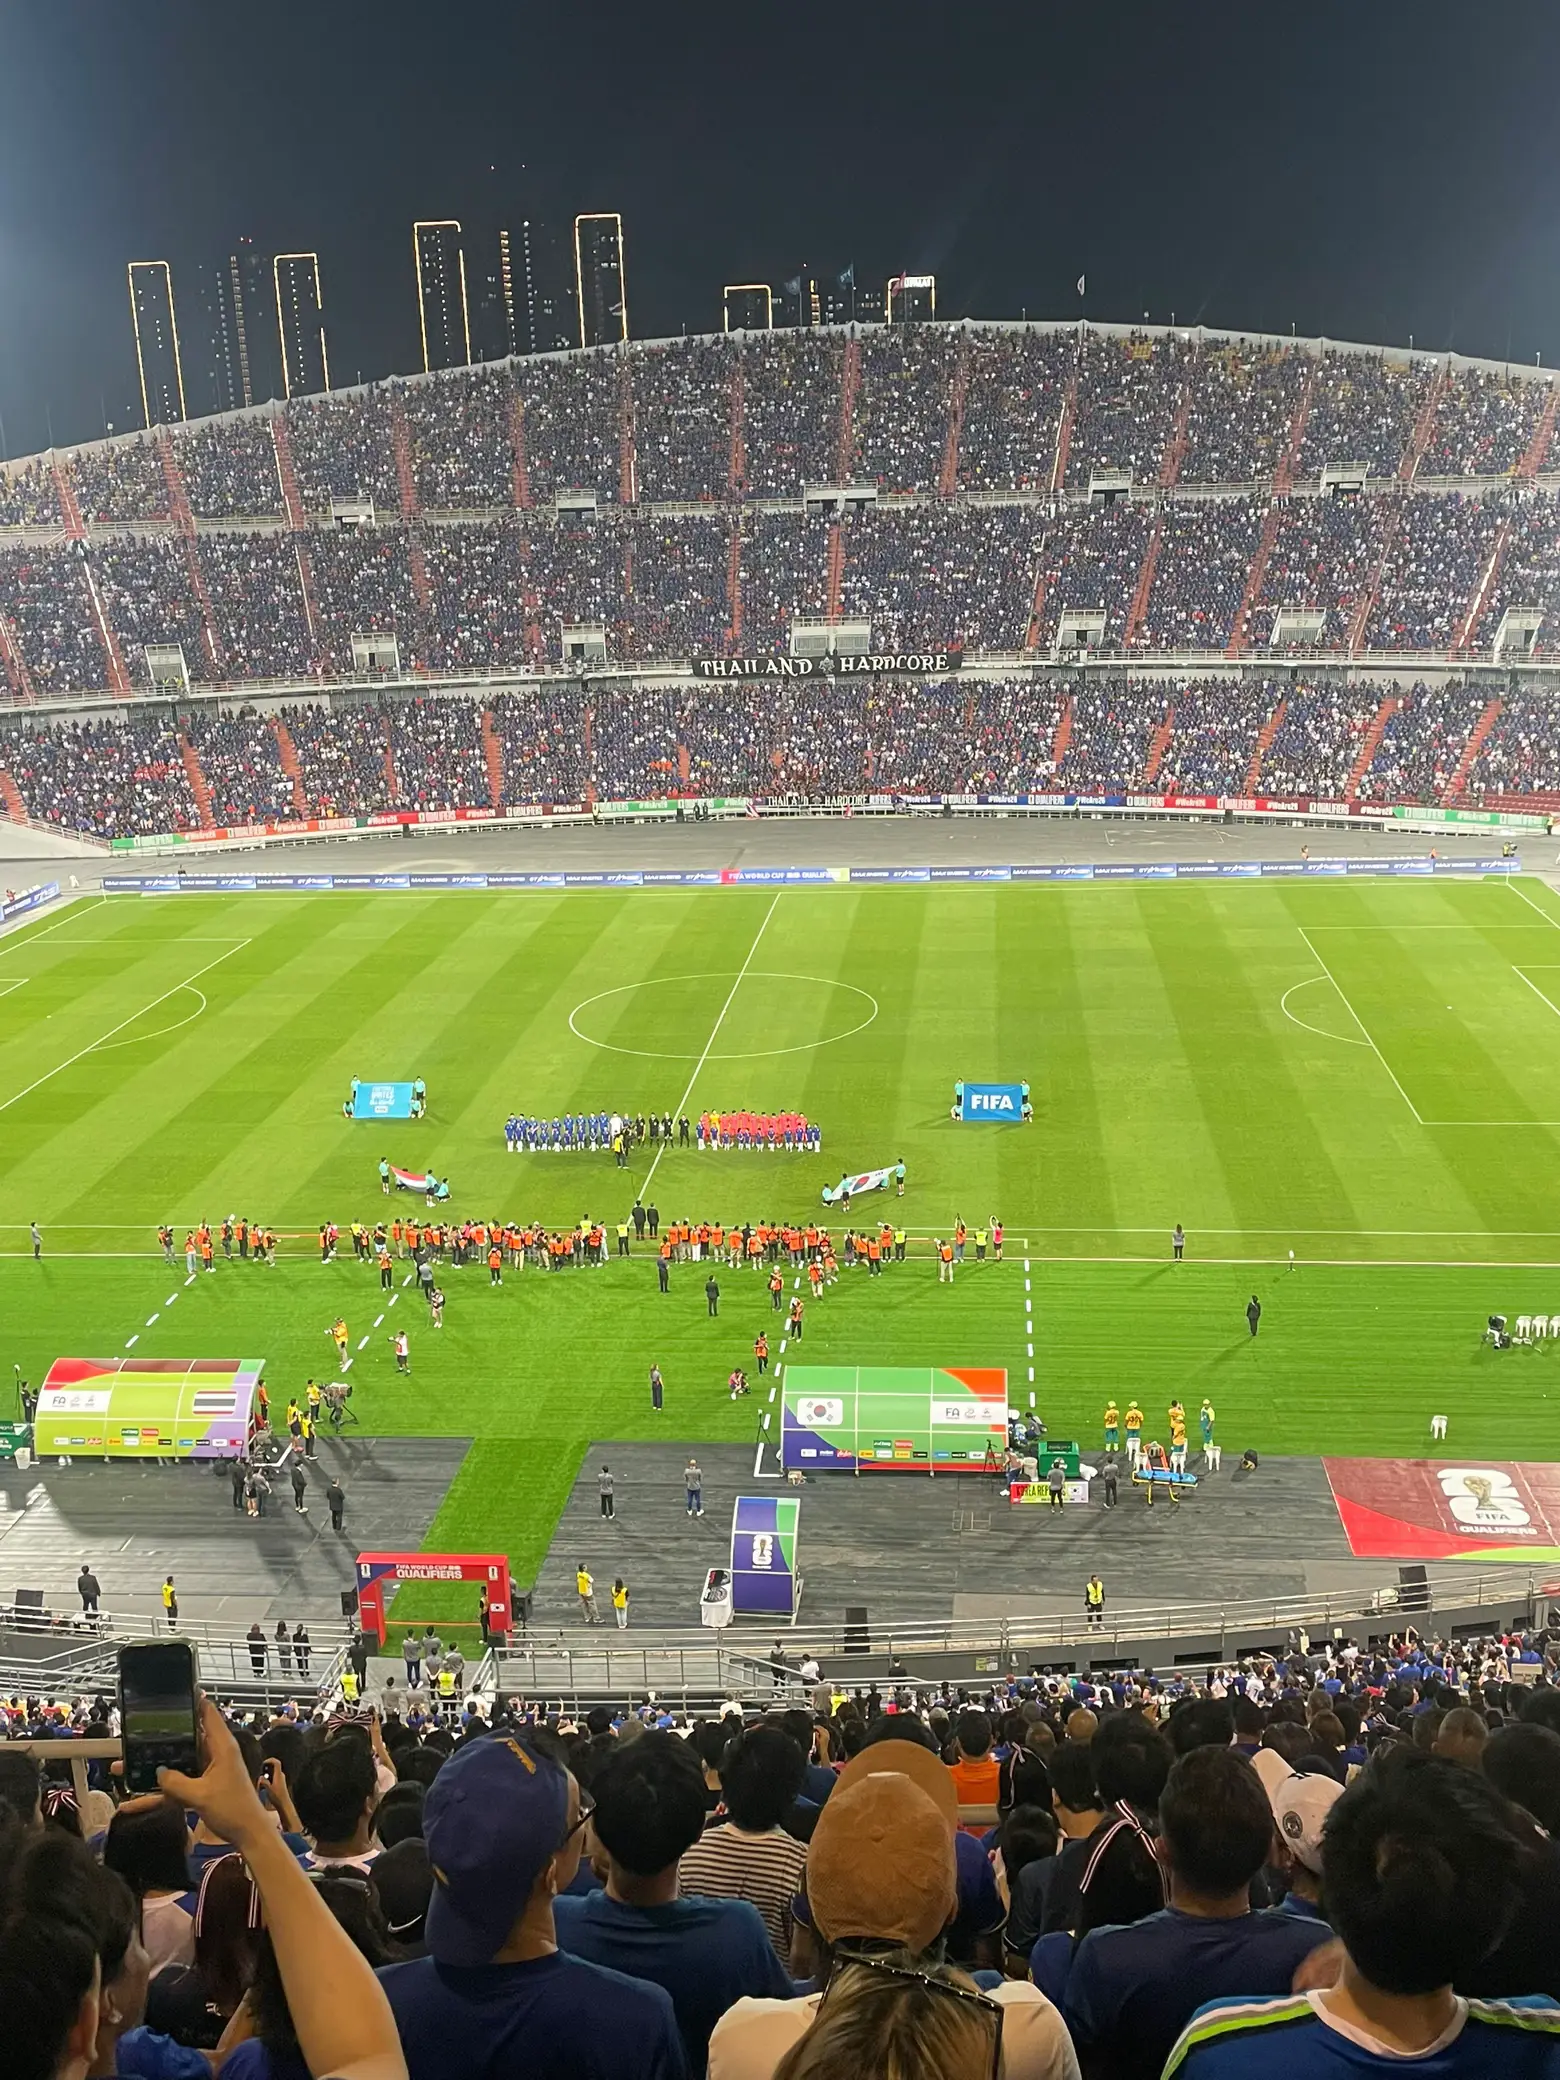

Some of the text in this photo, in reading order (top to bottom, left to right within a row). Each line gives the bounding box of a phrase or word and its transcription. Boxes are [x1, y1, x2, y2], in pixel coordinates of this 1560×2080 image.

[700, 654, 950, 677] THAILAND HARDCORE
[824, 796, 868, 806] HARDCORE
[950, 794, 978, 804] QUALIFIERS
[1036, 794, 1064, 805] QUALIFIERS
[1134, 796, 1164, 808] QUALIFIERS
[512, 806, 543, 817] QUALIFIERS
[1317, 802, 1350, 814] QUALIFIERS
[971, 1094, 1014, 1110] FIFA
[1460, 1526, 1538, 1534] QUALIFIERS
[396, 1570, 462, 1579] QUALIFIERS
